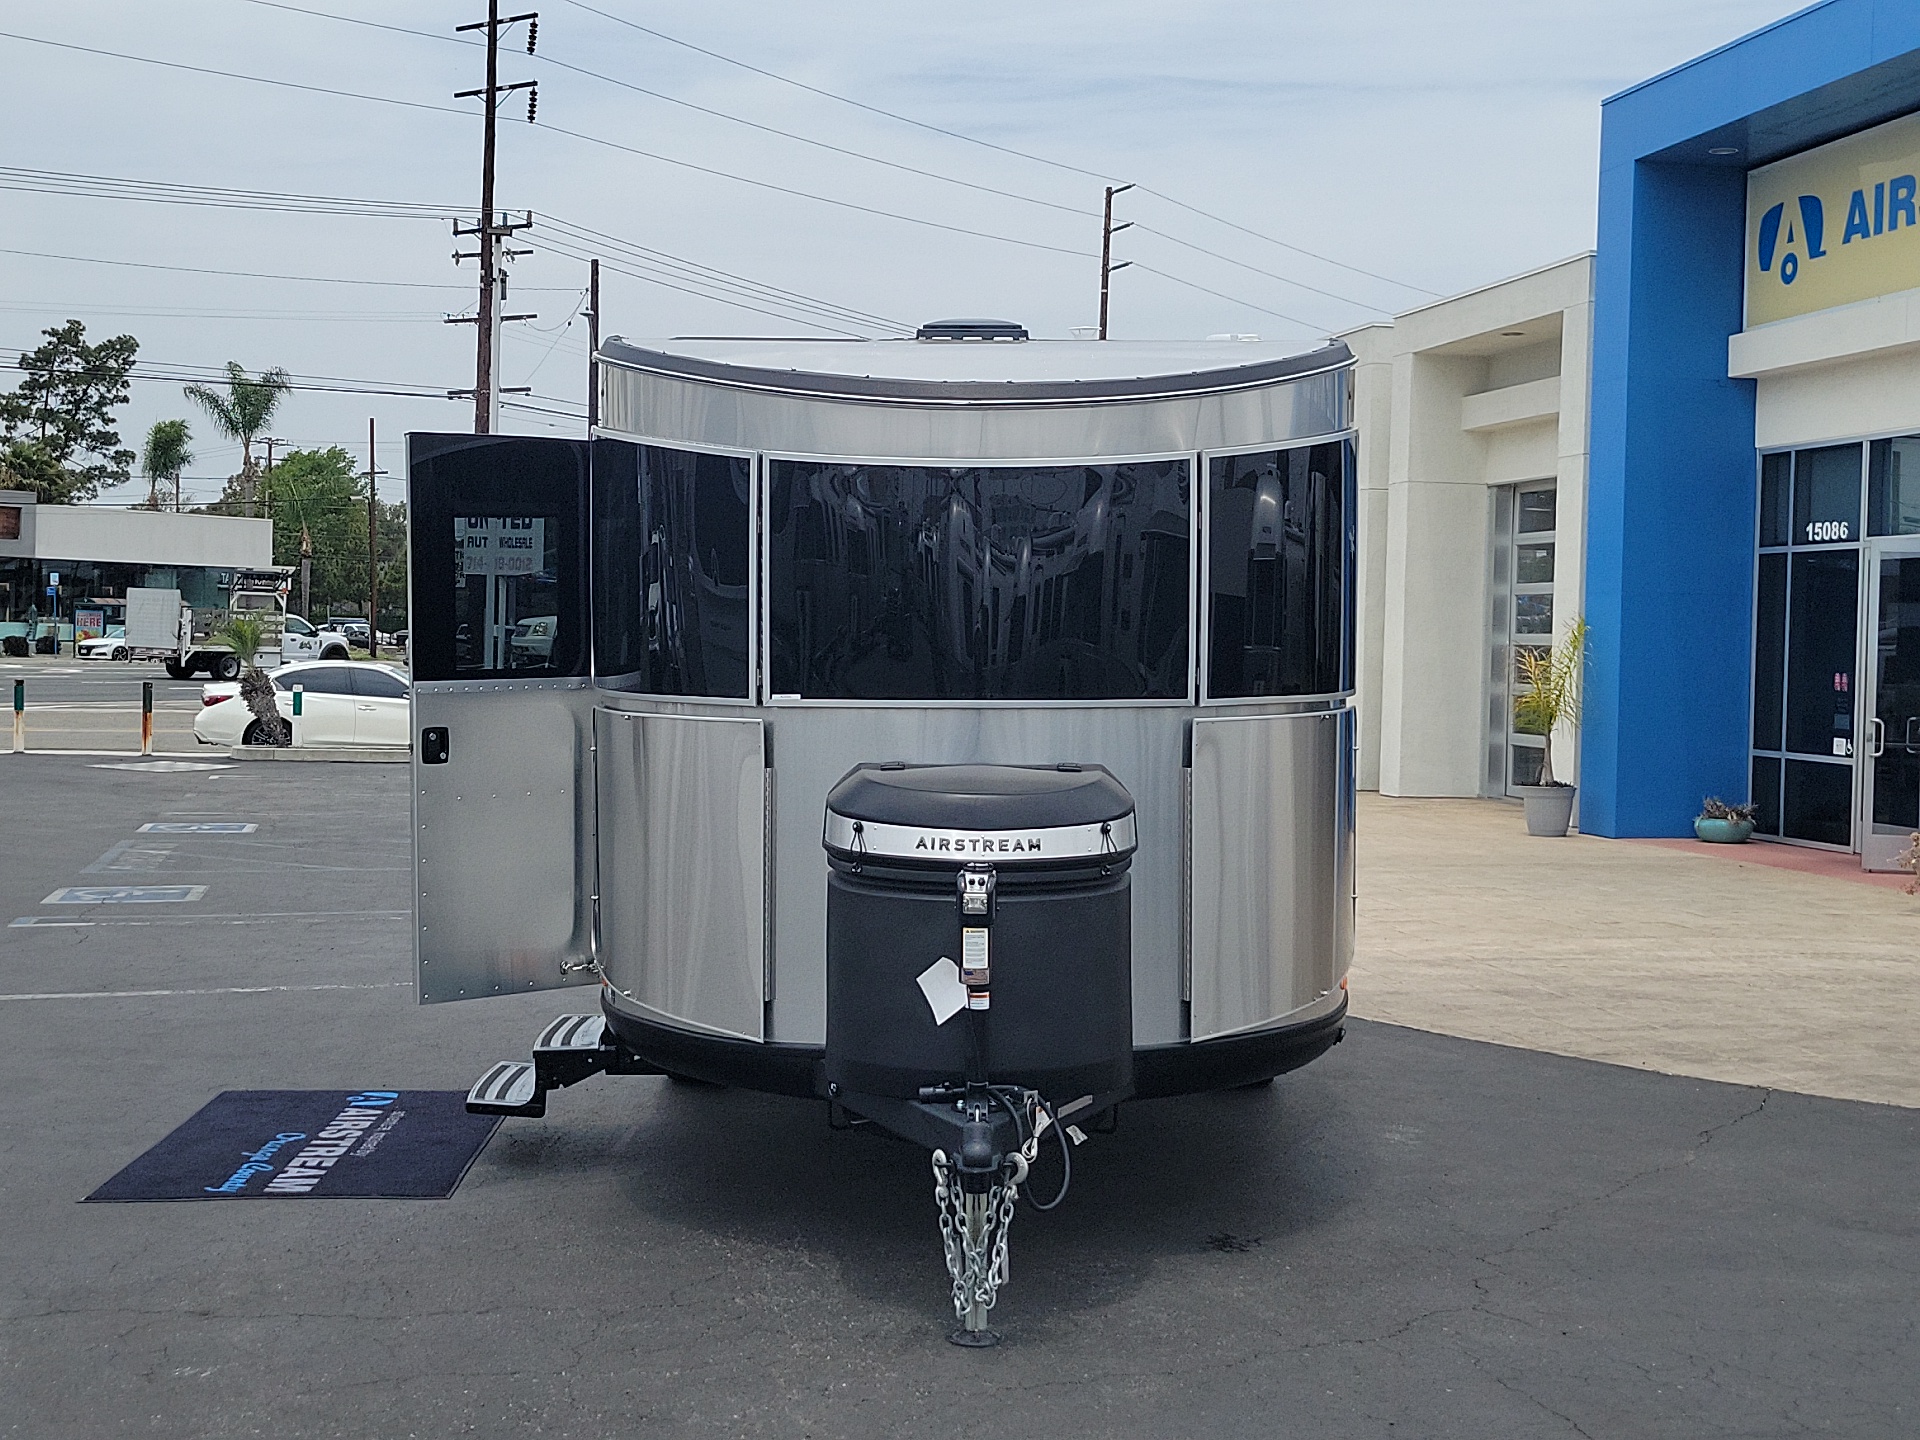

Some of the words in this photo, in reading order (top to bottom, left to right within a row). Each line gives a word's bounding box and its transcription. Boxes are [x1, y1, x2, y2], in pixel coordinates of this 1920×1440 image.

[1842, 174, 1920, 246] AIR
[468, 517, 533, 529] UNTED
[1805, 521, 1849, 541] 15086
[466, 535, 489, 549] AUT
[76, 617, 102, 627] HERE
[915, 836, 1042, 852] AIRSTREAM
[263, 1107, 385, 1192] AIRSTREAM
[203, 1162, 274, 1193] County
